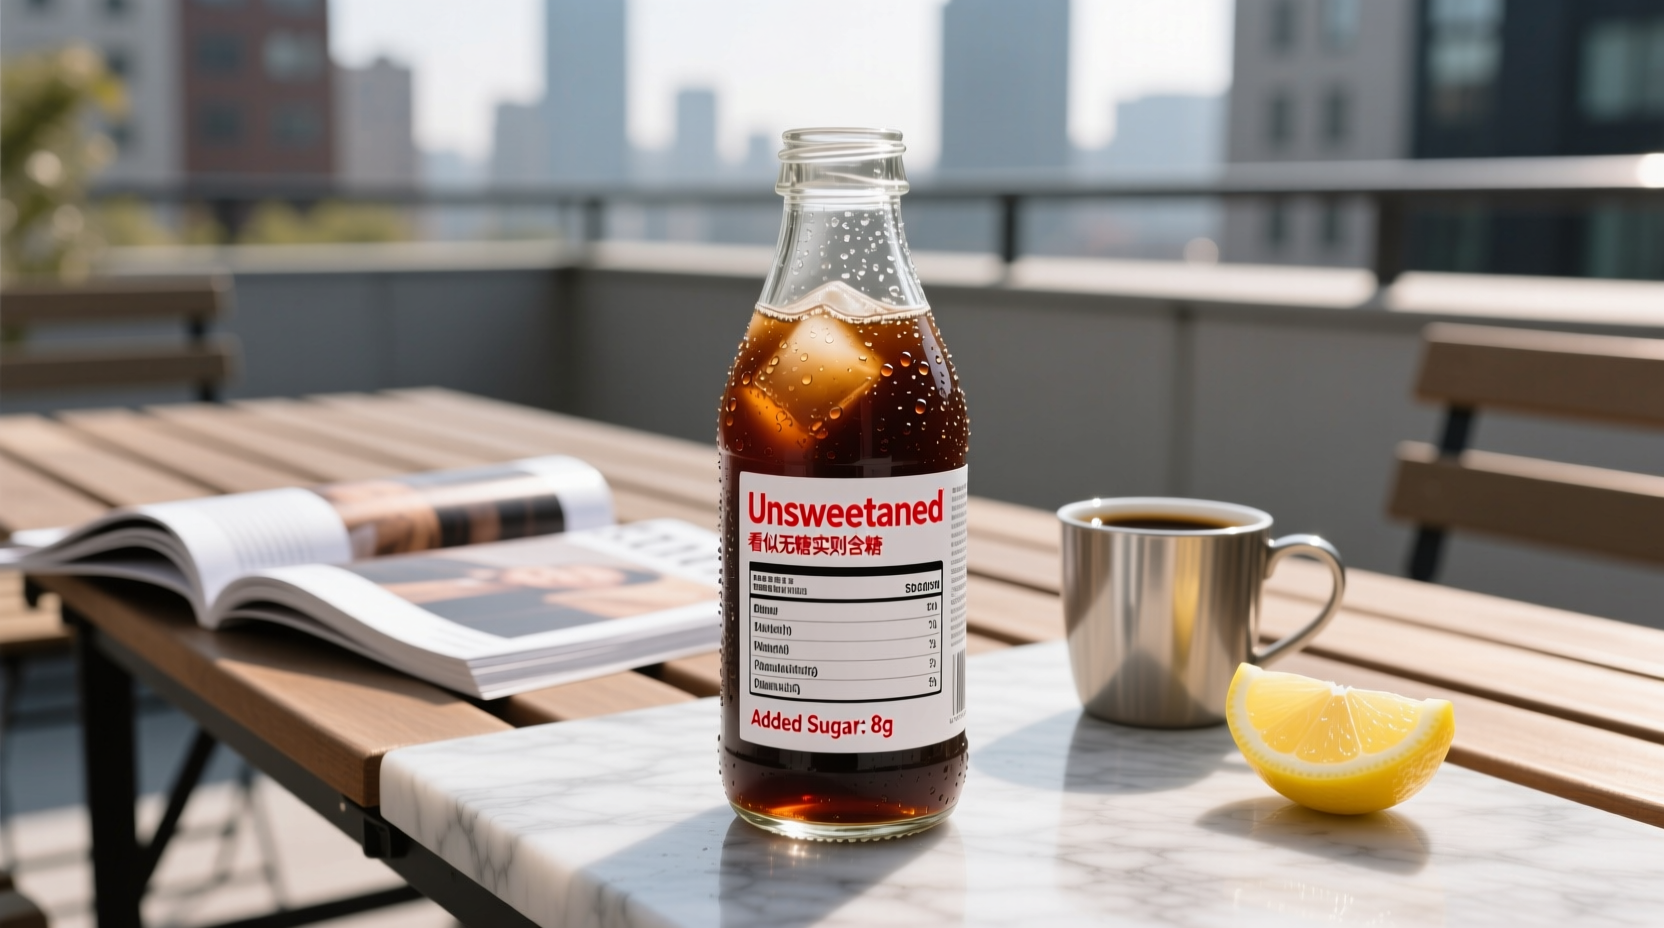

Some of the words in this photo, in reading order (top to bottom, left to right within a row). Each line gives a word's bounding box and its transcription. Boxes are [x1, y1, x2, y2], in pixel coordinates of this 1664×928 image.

[749, 487, 943, 528] Unsweetaned
[748, 532, 883, 556] 看似无糖实则含糖
[751, 709, 802, 732] Added
[807, 715, 866, 739] Sugar:
[871, 714, 893, 738] 8g
